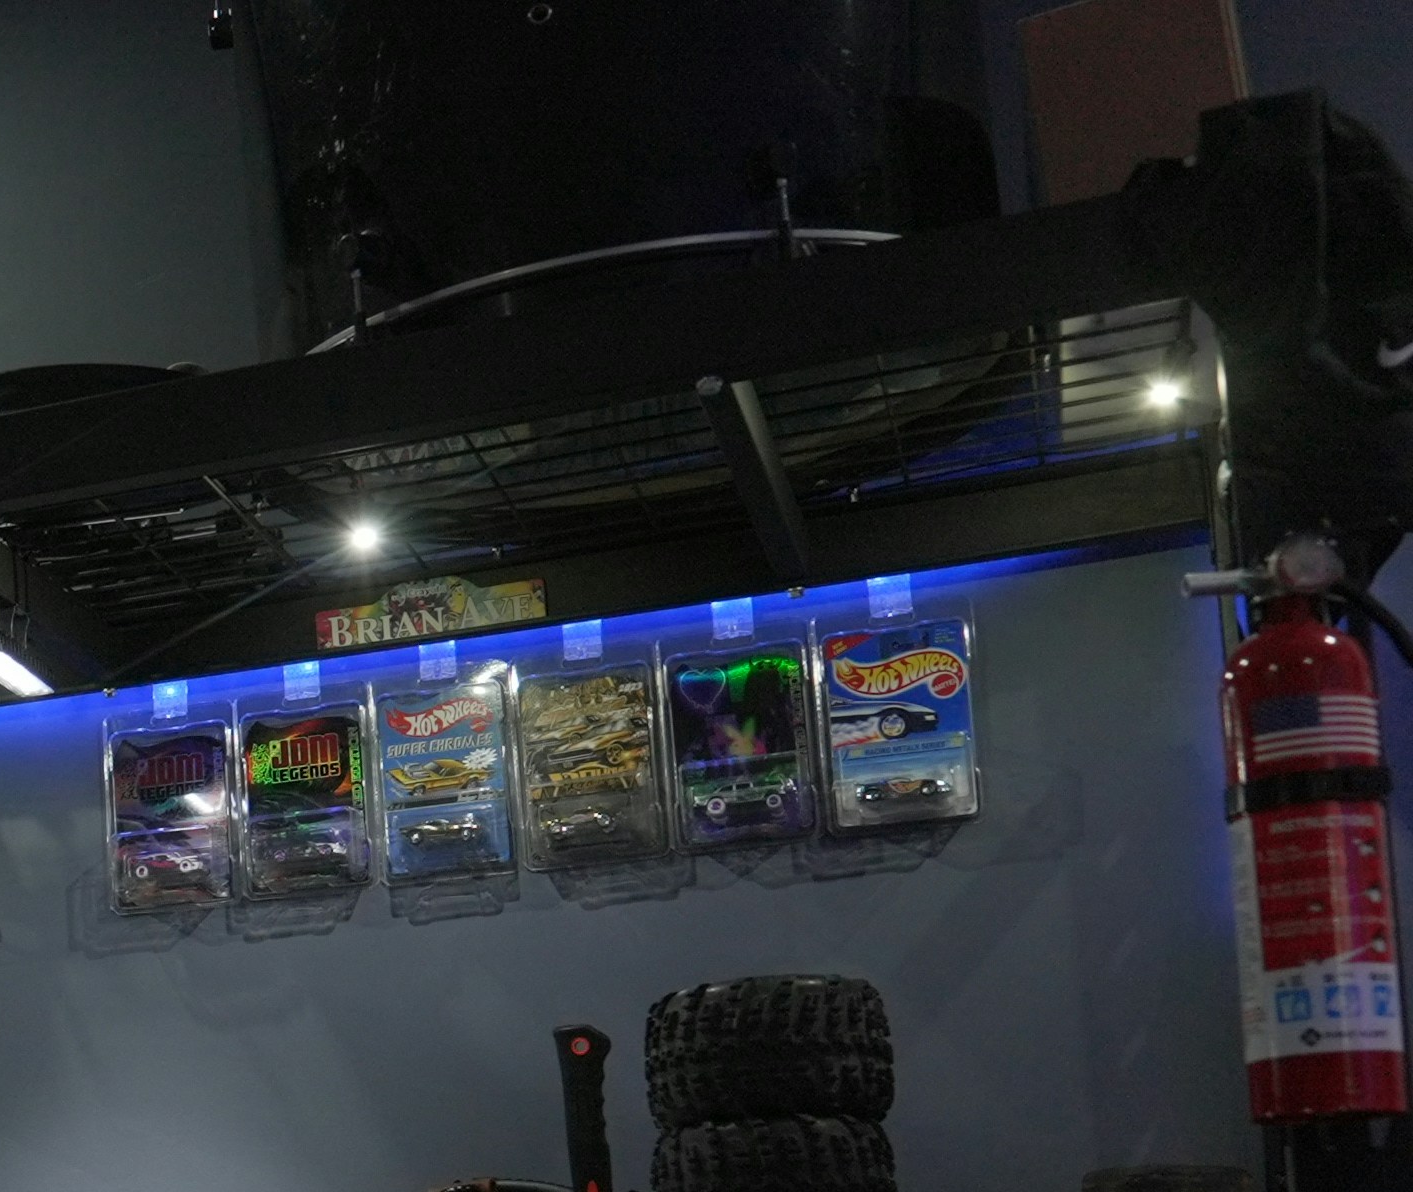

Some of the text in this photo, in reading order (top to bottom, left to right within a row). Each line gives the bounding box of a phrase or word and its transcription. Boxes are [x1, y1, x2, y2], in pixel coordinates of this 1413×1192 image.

[327, 592, 534, 648] BRIAN AVE
[270, 731, 340, 769] JDM
[387, 733, 493, 758] SUPER CHROMES
[137, 752, 205, 787] JDM
[271, 762, 342, 782] LEGENDS
